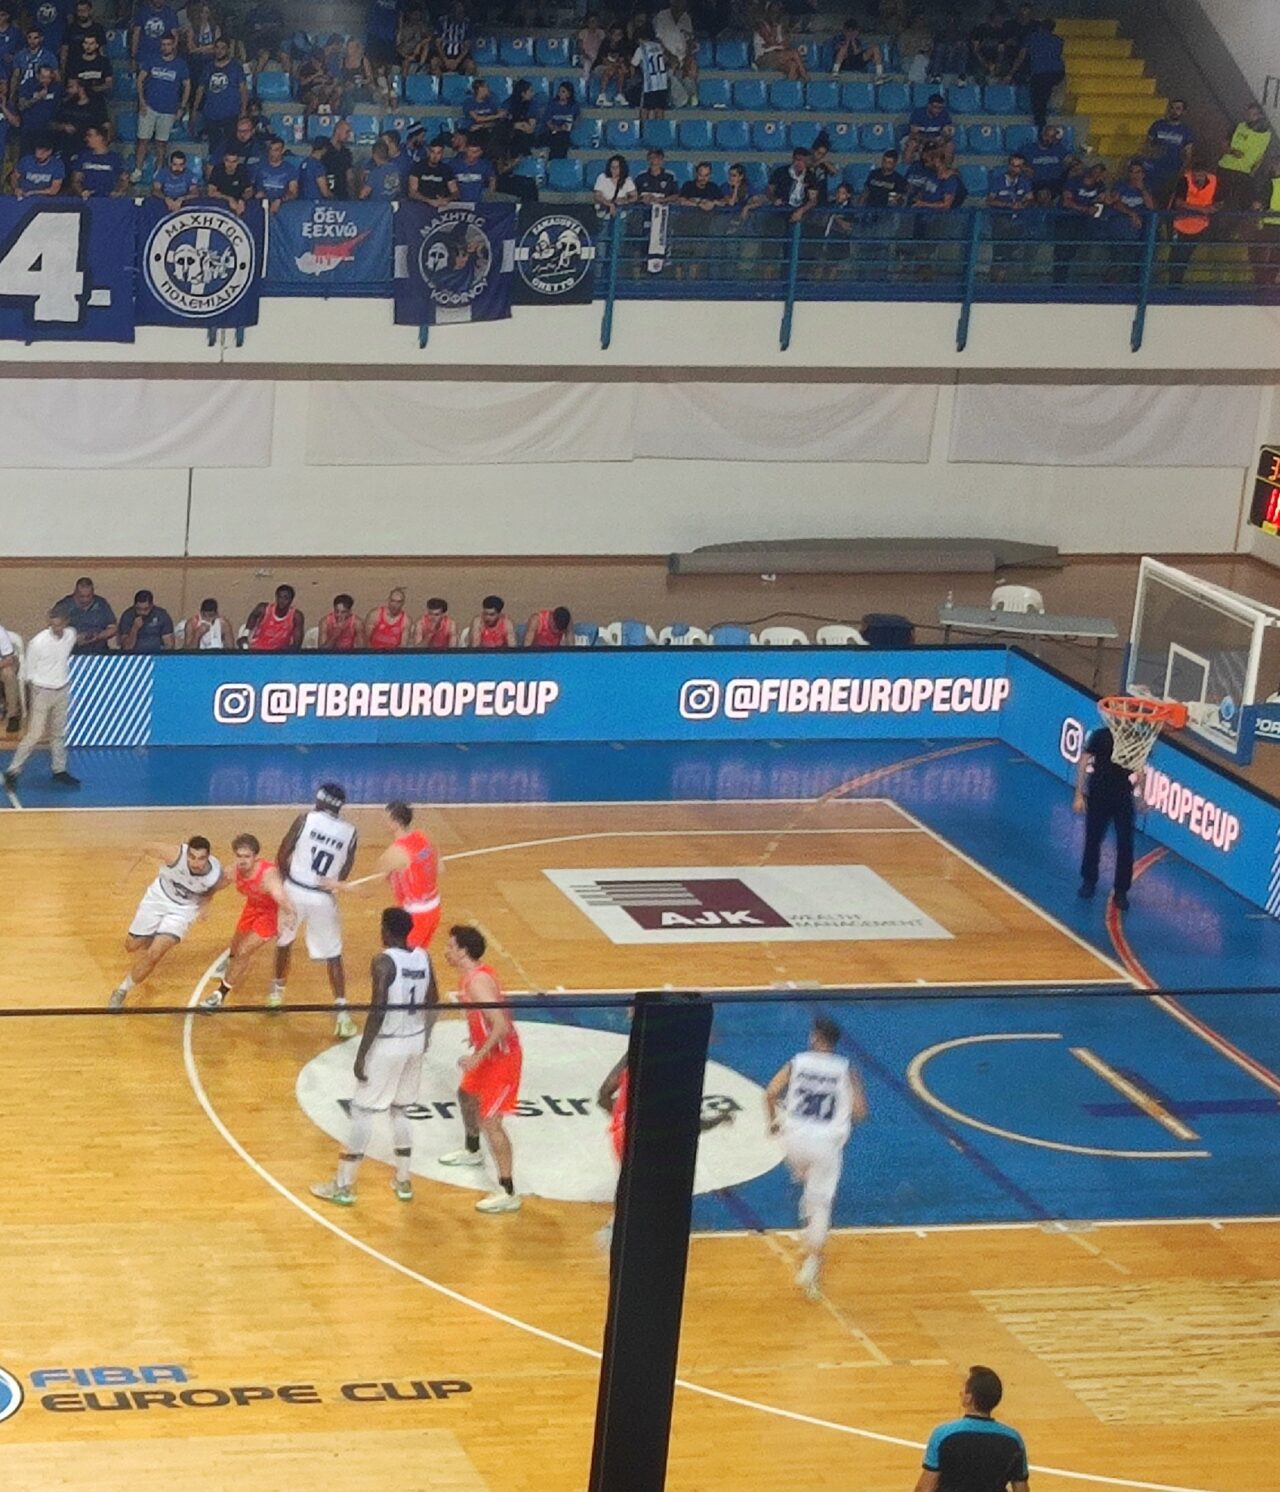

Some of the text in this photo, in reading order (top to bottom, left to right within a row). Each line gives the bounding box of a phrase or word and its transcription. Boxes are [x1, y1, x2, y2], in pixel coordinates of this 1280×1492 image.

[261, 681, 558, 723] @FIBAEUROPECUP
[724, 678, 1009, 719] @FIBAEUROPECUP
[311, 846, 334, 876] 10
[661, 910, 764, 926] AJK
[29, 1365, 189, 1388] FIBA
[41, 1380, 474, 1413] EUROPE CUP
